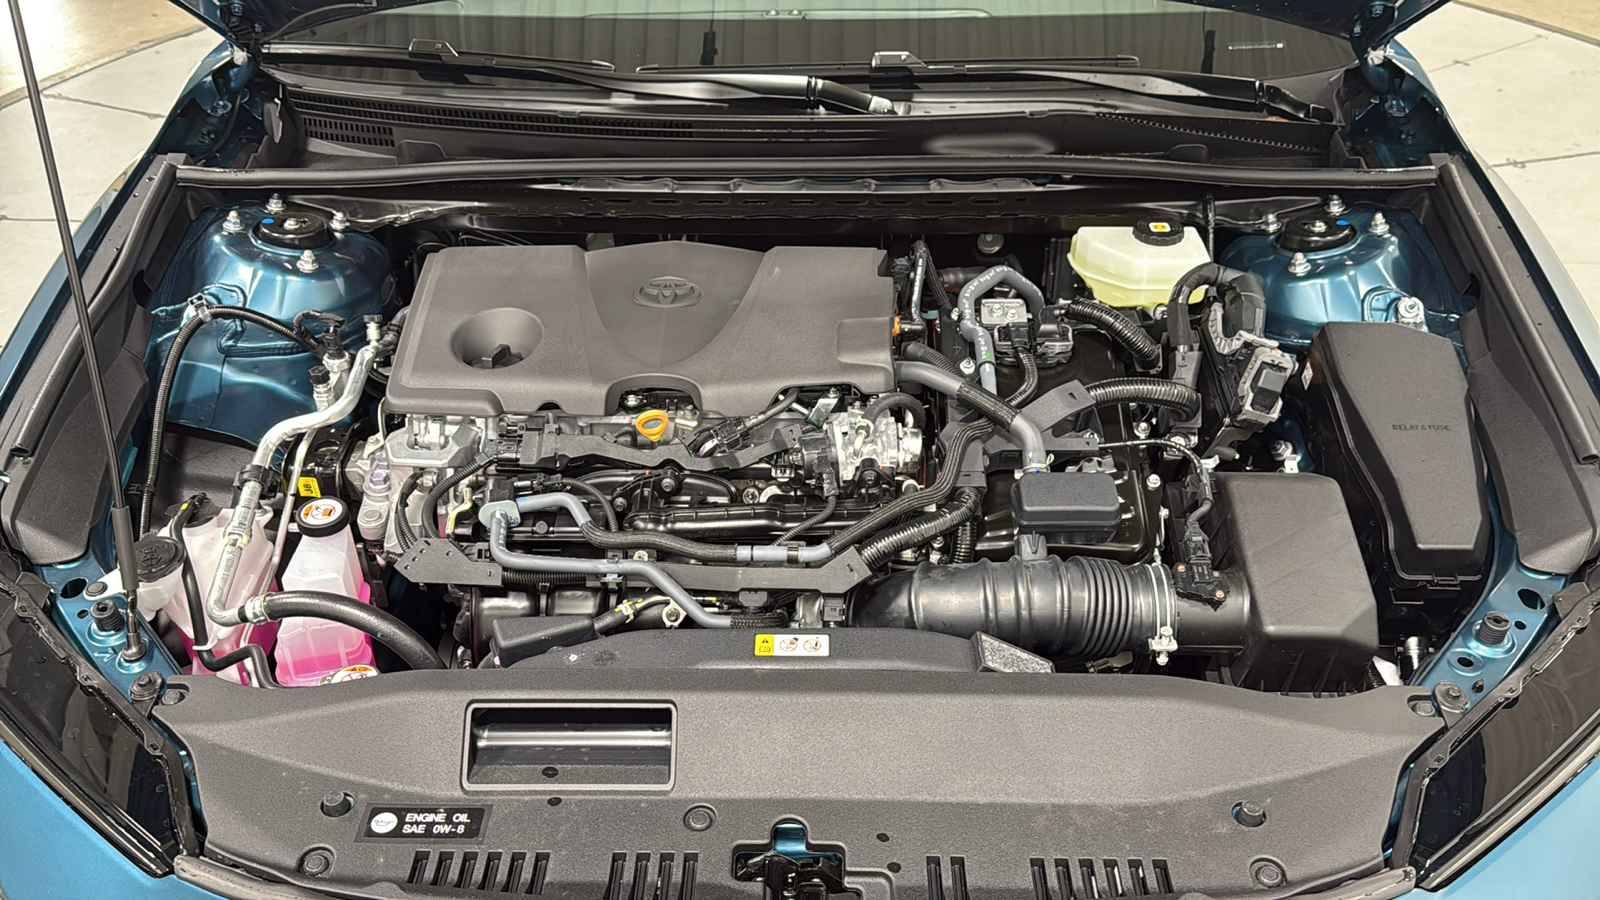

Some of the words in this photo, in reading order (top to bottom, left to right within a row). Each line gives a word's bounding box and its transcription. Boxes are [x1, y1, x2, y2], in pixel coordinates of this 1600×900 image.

[303, 484, 313, 494] J8
[405, 813, 447, 823] ENGINE
[452, 813, 471, 823] OIL
[402, 824, 426, 834] SAE
